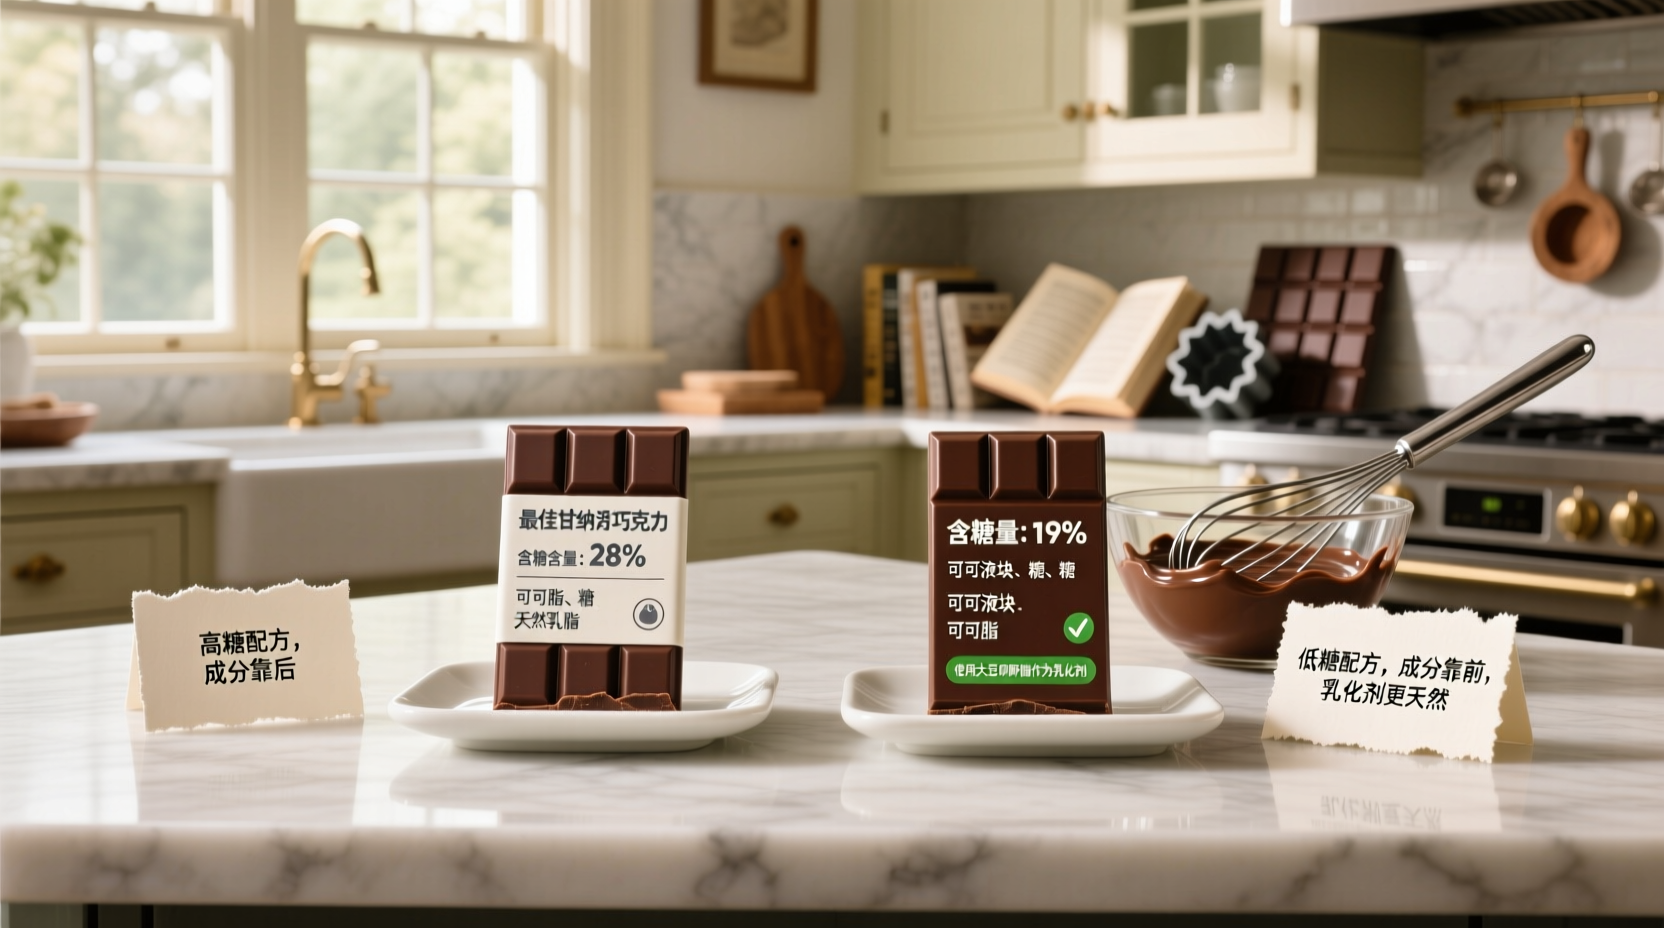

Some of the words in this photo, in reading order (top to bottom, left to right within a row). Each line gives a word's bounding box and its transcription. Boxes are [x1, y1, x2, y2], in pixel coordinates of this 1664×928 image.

[199, 627, 300, 657] 高糖配方,
[948, 621, 998, 640] 可可脂
[204, 656, 296, 686] 成分靠后
[1297, 646, 1491, 686] 低糖配方,成分靠前,
[1320, 678, 1450, 712] 乳化剂更天然
